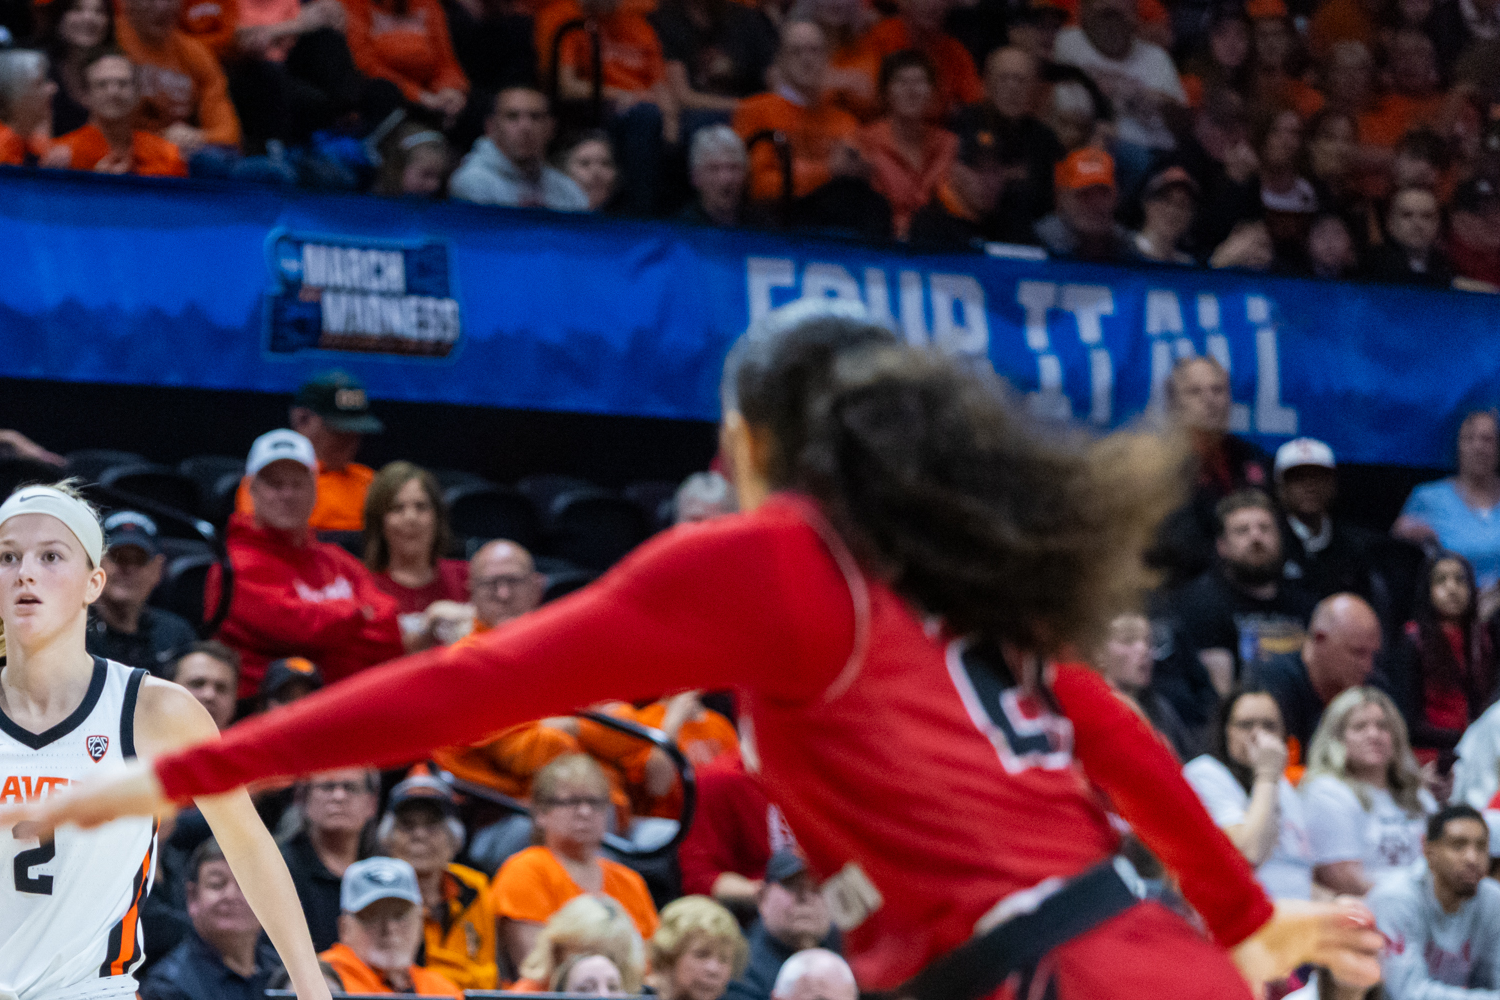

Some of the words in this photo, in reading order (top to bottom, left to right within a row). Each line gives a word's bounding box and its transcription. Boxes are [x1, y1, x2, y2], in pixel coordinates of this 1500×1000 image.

[302, 243, 406, 291] MARCH
[320, 291, 460, 342] MADNESS
[1145, 289, 1298, 436] ALL
[87, 736, 108, 752] PAC
[92, 746, 103, 757] 12
[11, 819, 56, 896] 2
